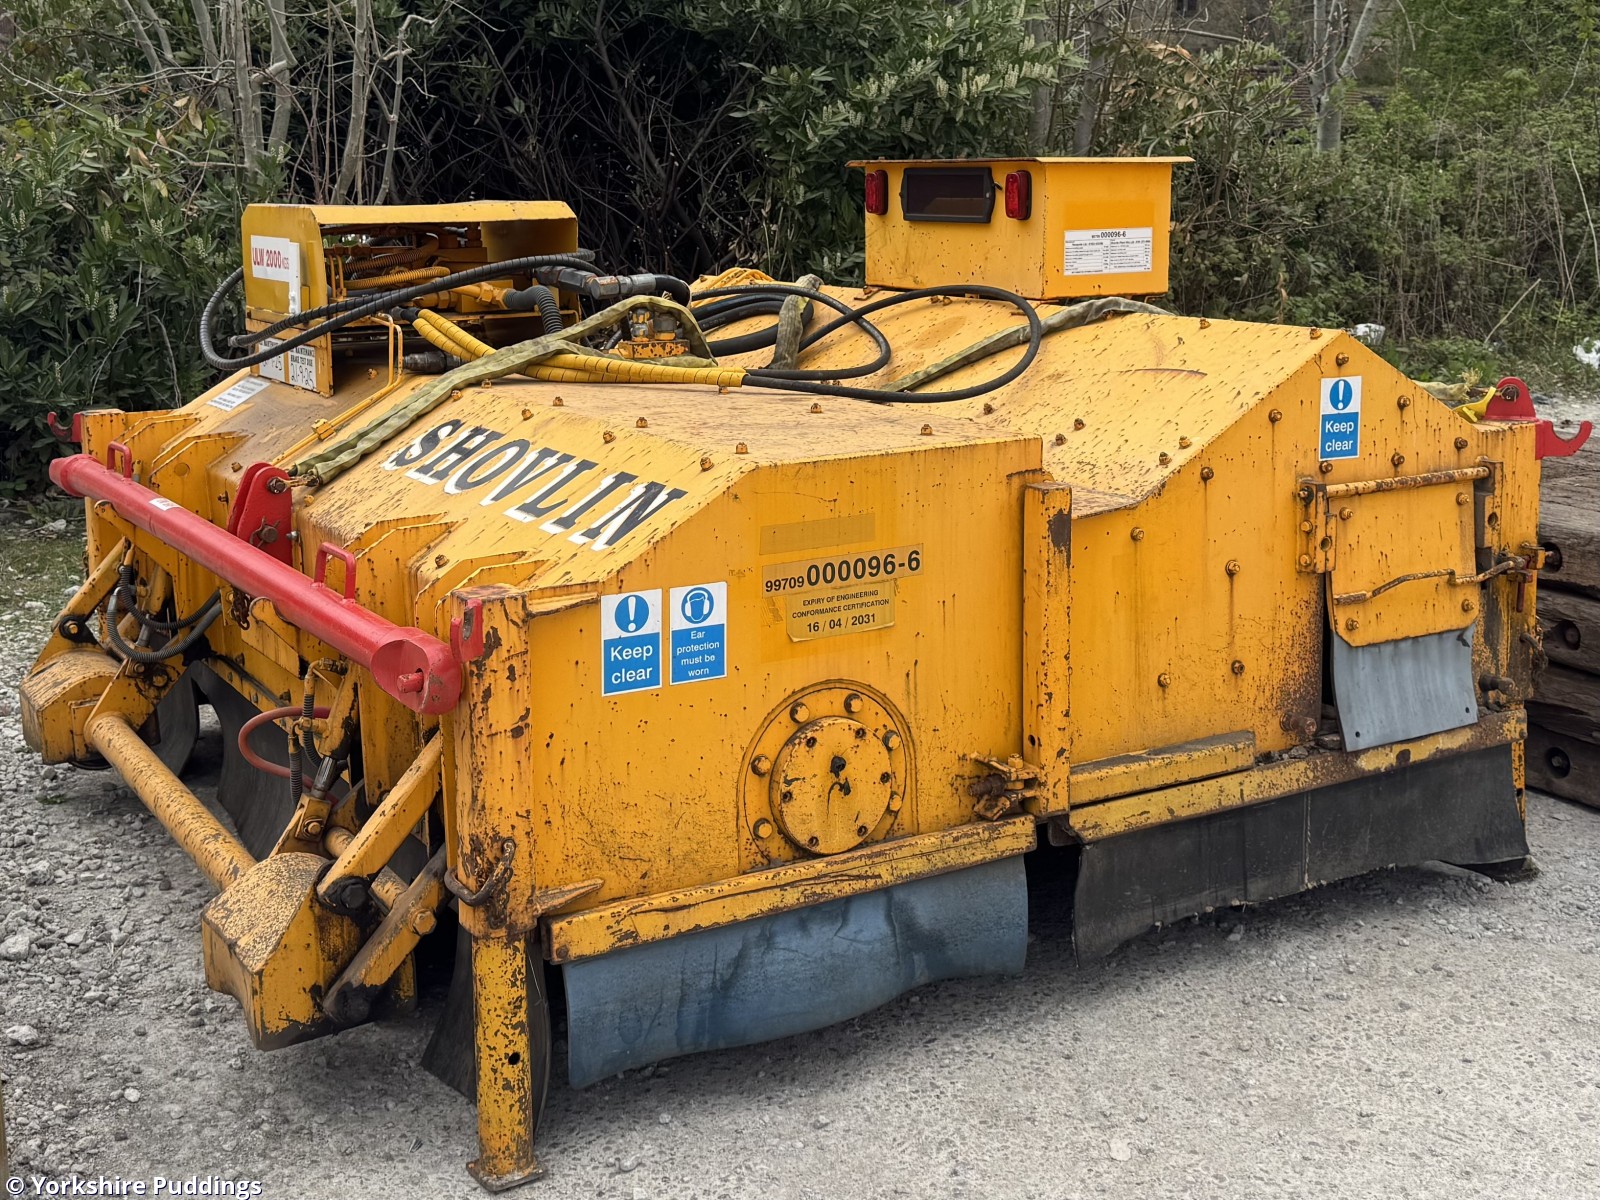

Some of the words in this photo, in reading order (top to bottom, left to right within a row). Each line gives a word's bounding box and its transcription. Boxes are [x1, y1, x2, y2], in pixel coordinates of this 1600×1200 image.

[252, 247, 264, 266] ULW
[266, 249, 281, 269] 2000
[1325, 421, 1354, 435] Keep
[1325, 439, 1353, 452] clear
[380, 418, 689, 552] SHOVLIN
[765, 575, 805, 593] 99709
[806, 549, 921, 587] 000096-6
[802, 597, 826, 607] EXPIRY
[836, 589, 879, 601] ENGINEERING
[792, 605, 842, 619] CONFORMANCE
[843, 598, 890, 612] CERTIFICATION
[807, 621, 820, 633] 16
[828, 618, 842, 630] 04
[851, 613, 877, 626] 2031
[690, 630, 705, 640] Ear
[610, 644, 653, 662] Keep
[676, 641, 720, 656] protection
[681, 656, 703, 666] must
[704, 654, 716, 662] be
[611, 667, 653, 684] clear
[688, 667, 710, 677] worn
